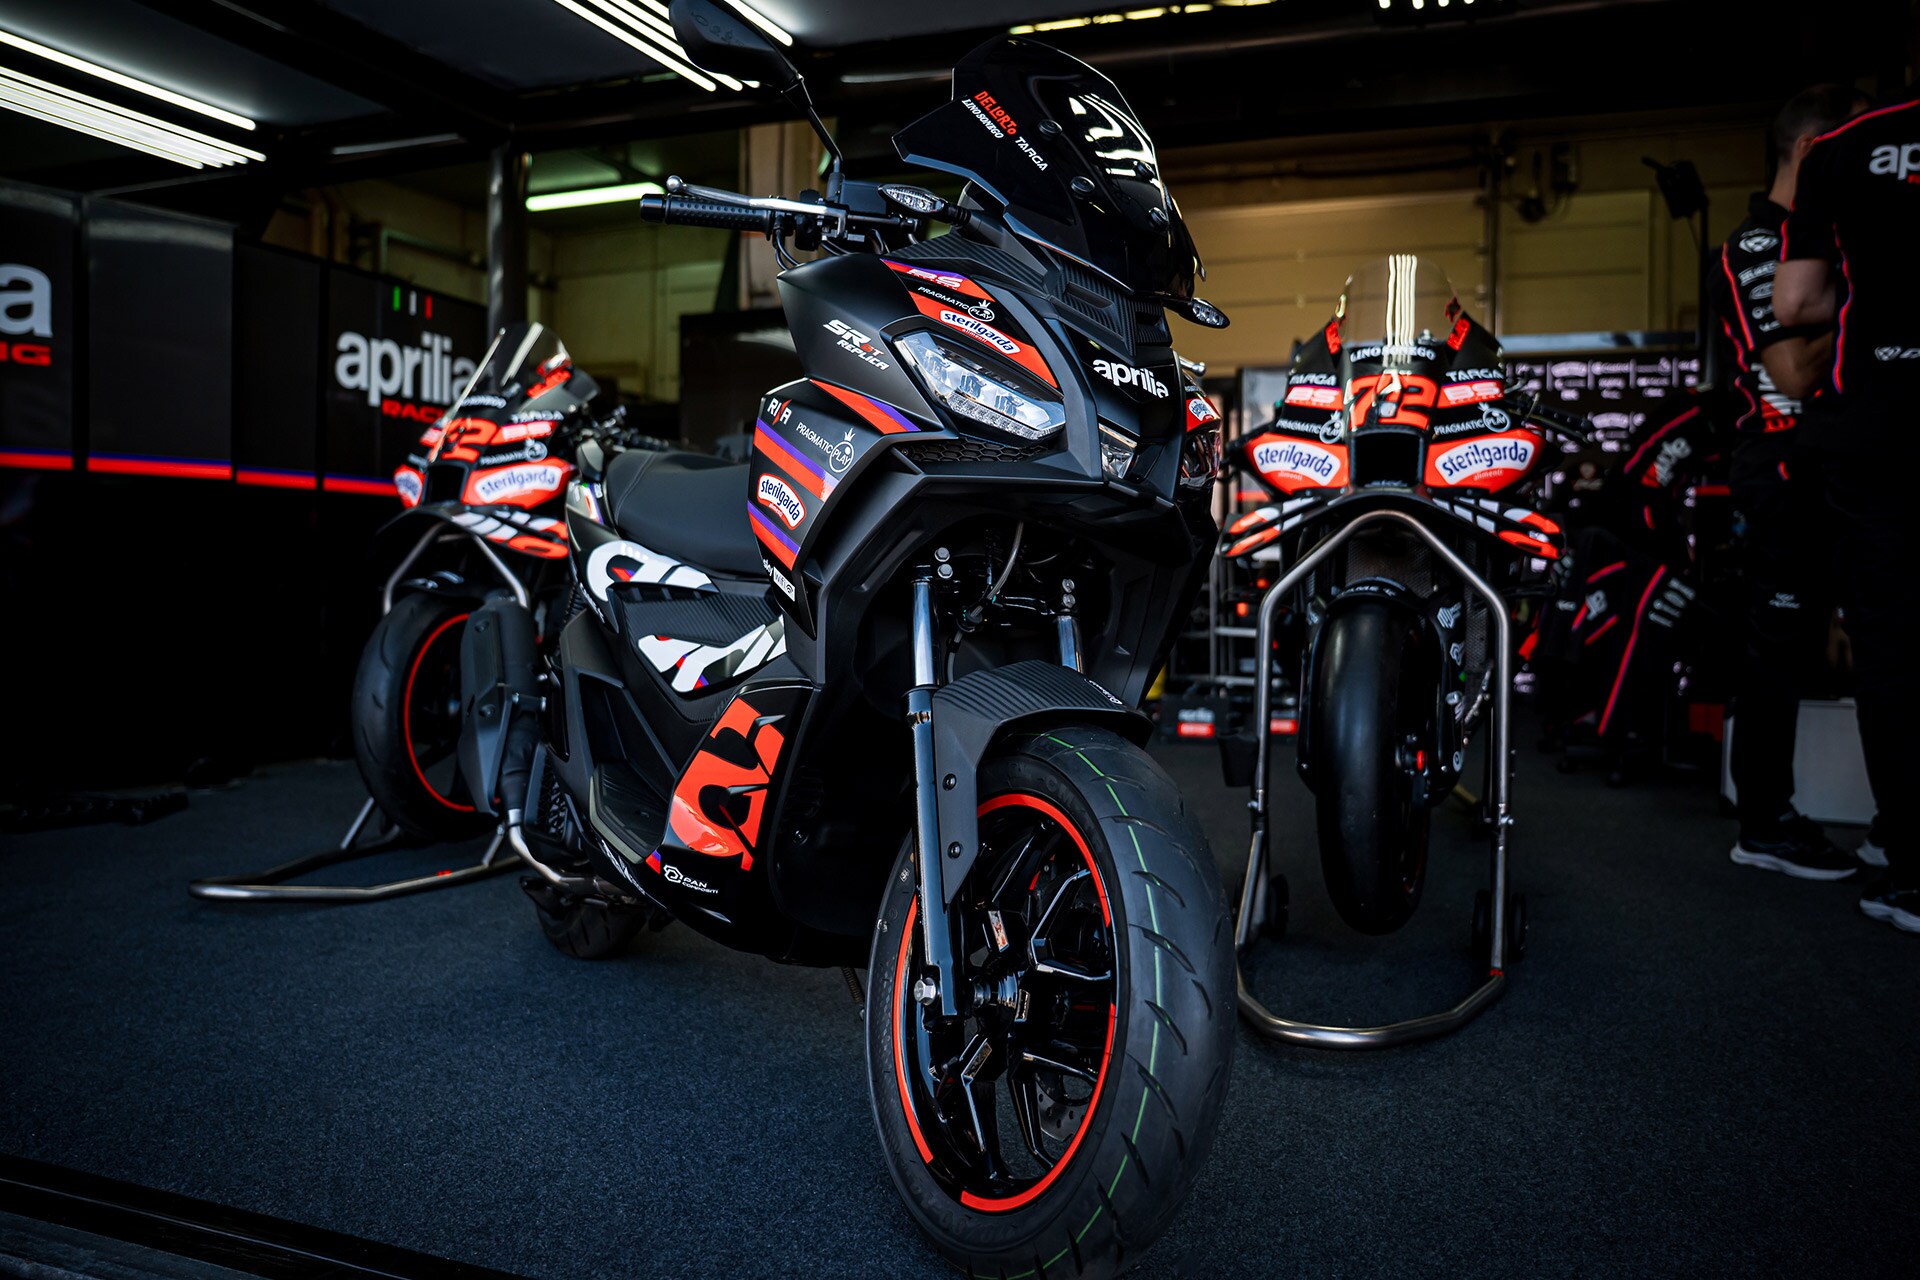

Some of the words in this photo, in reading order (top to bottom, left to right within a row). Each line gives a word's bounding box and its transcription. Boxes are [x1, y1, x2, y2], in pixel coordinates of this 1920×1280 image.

[961, 98, 982, 115] LINO
[1015, 136, 1048, 171] TARGA
[918, 286, 970, 310] PRAGMATIC
[970, 307, 992, 320] PLAY
[944, 312, 1014, 351] sterilgarda
[836, 340, 890, 371] REPLICA
[1092, 359, 1170, 399] aprilia
[1445, 368, 1504, 382] TARGA
[1349, 371, 1438, 431] 72
[1275, 418, 1321, 435] PRAGMATIC
[1434, 419, 1485, 436] PRAGMATIC
[796, 422, 834, 455] PRAGMATIC
[833, 449, 851, 466] PLAY
[1258, 443, 1334, 478] sterilgarda
[1442, 441, 1528, 477] sterilgarda
[481, 468, 556, 496] sterilgarda
[760, 479, 801, 521] sterilgarda
[683, 876, 707, 888] PAN
